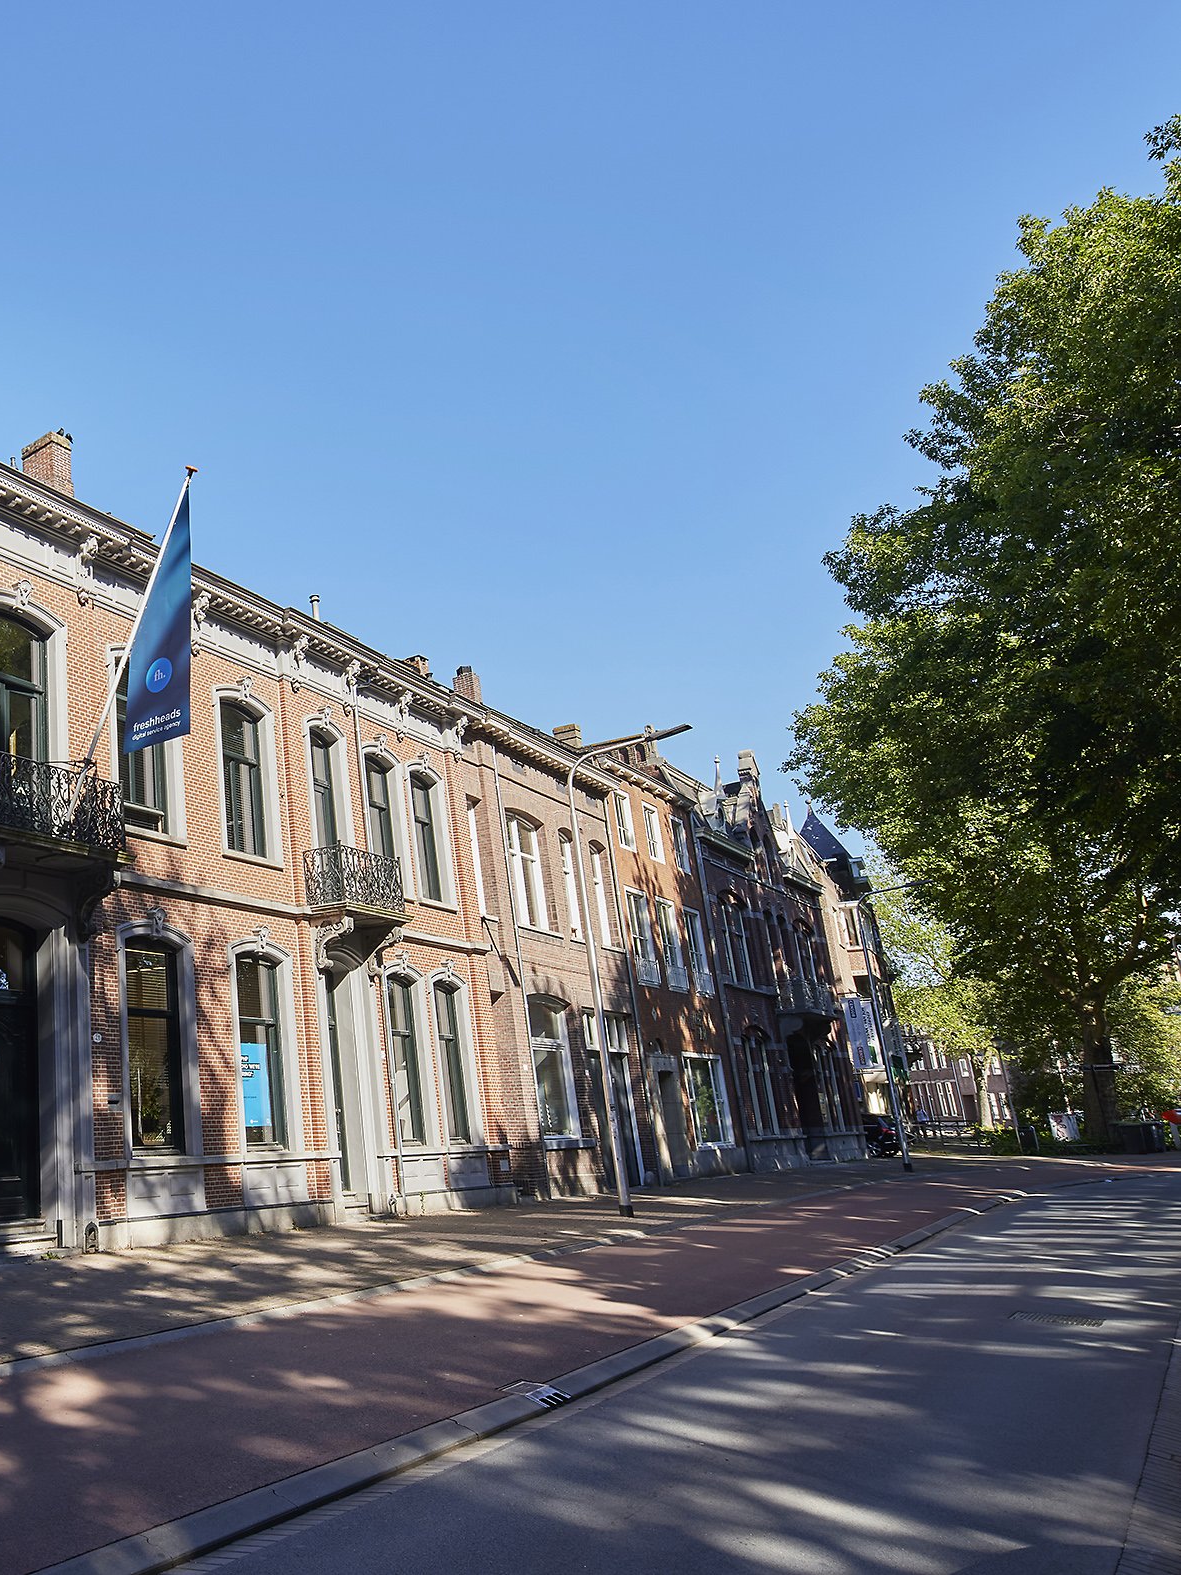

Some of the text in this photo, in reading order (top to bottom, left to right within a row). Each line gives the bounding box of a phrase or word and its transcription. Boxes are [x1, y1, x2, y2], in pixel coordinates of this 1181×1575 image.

[131, 720, 181, 741] digital service agency
[133, 709, 181, 732] freshheads
